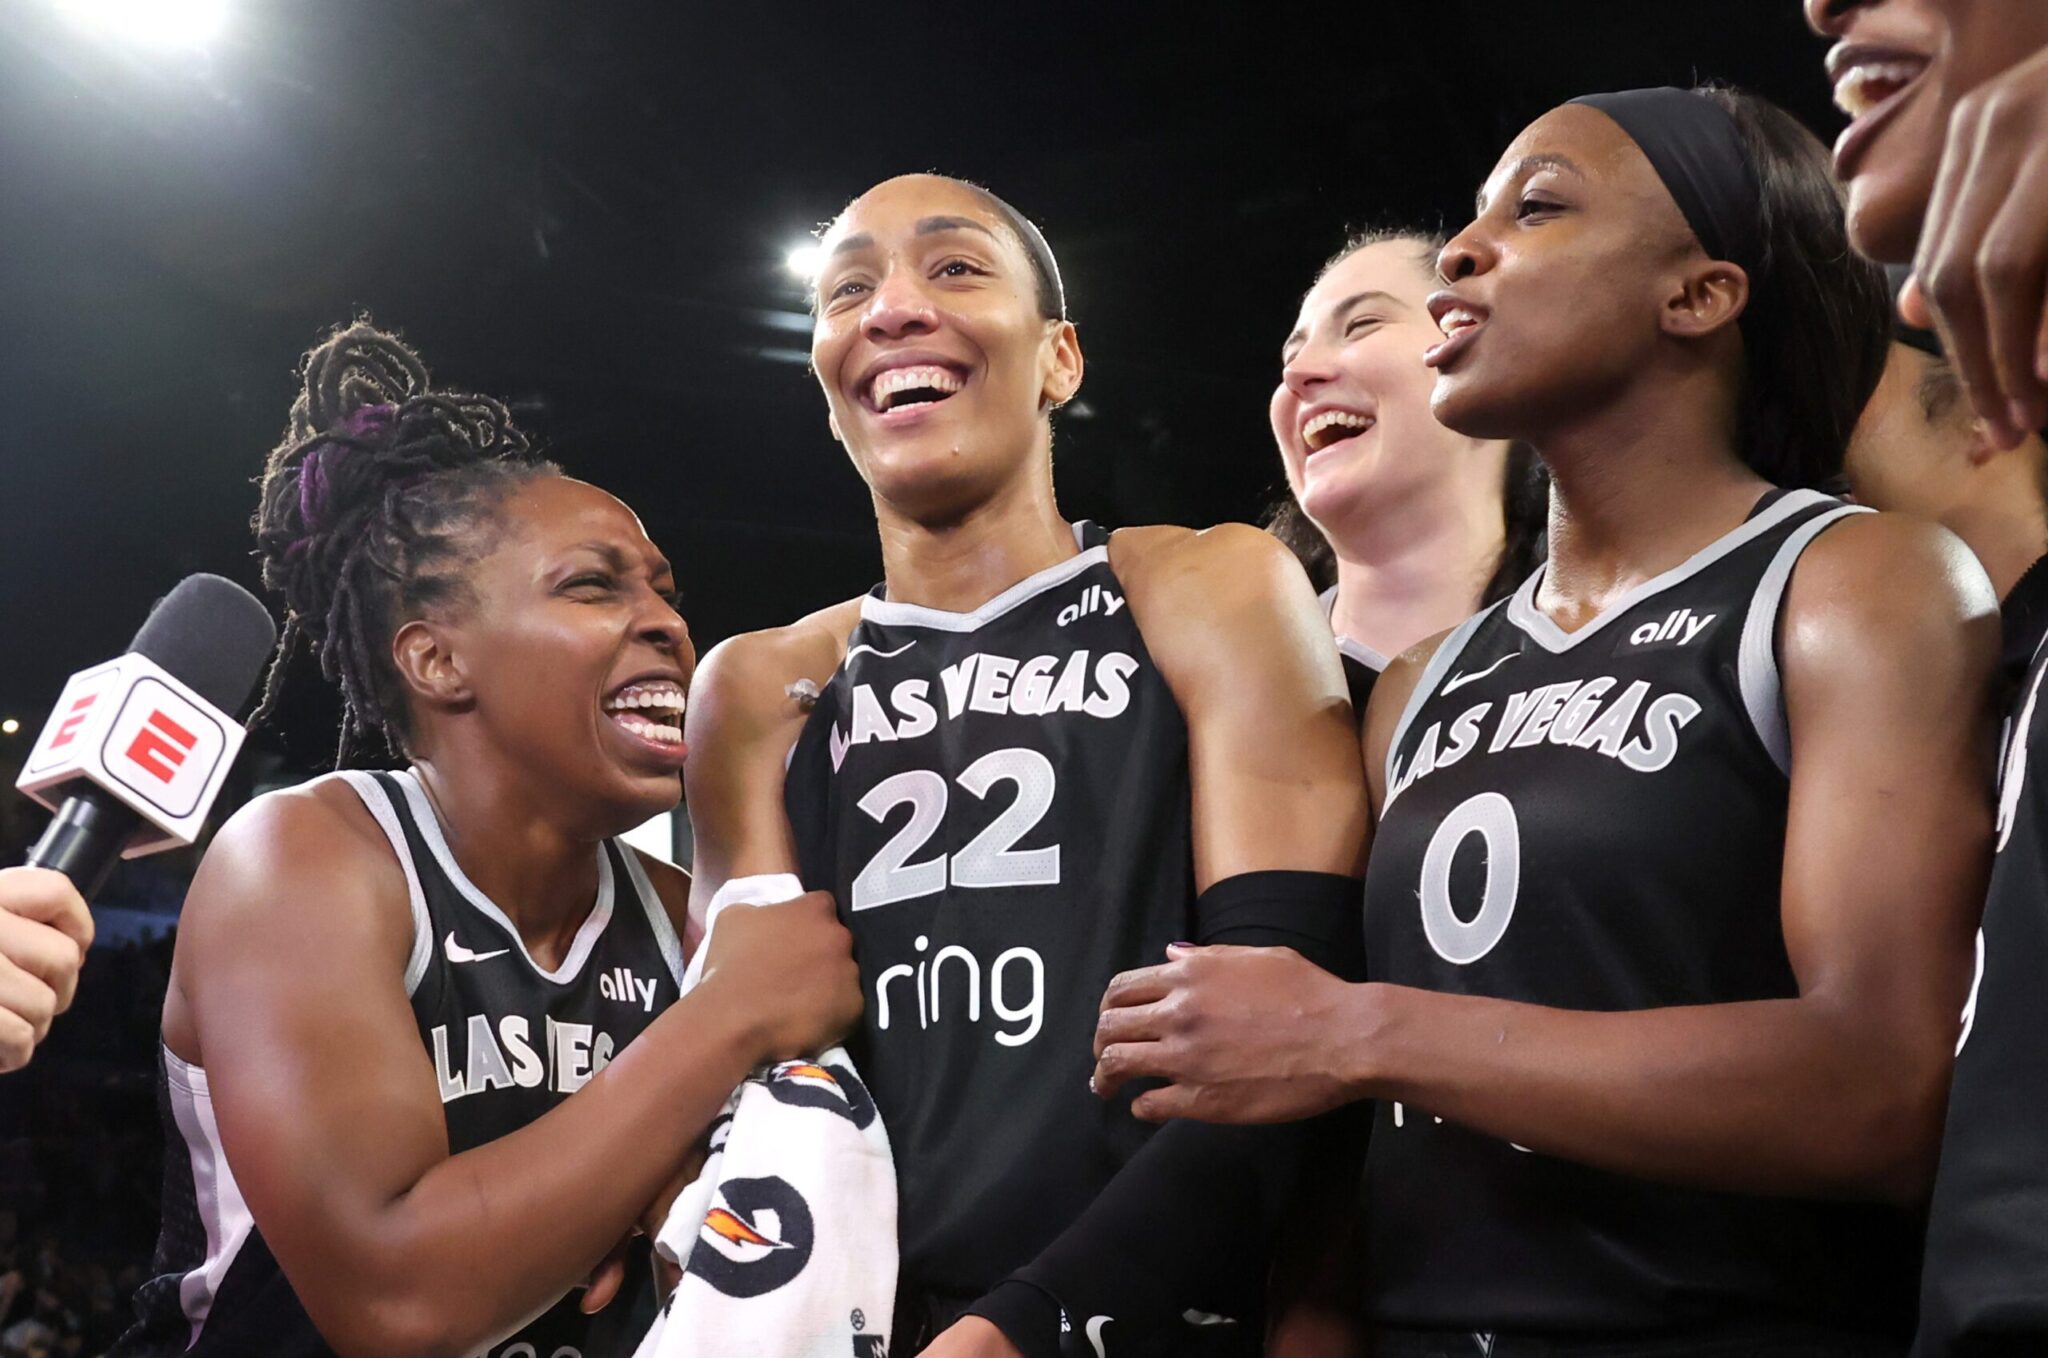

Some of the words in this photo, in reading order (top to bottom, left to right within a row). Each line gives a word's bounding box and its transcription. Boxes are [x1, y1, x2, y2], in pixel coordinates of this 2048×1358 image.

[1056, 584, 1125, 627] ally
[1629, 608, 1717, 646] ally
[939, 649, 1140, 720] VEGAS
[1379, 701, 1493, 822] LAS
[1487, 675, 1703, 773] VEGAS
[851, 747, 1060, 912] 22
[1419, 791, 1521, 965] 0
[599, 967, 658, 1012] ally
[876, 935, 1044, 1047] ring
[430, 1013, 544, 1104] LAS
